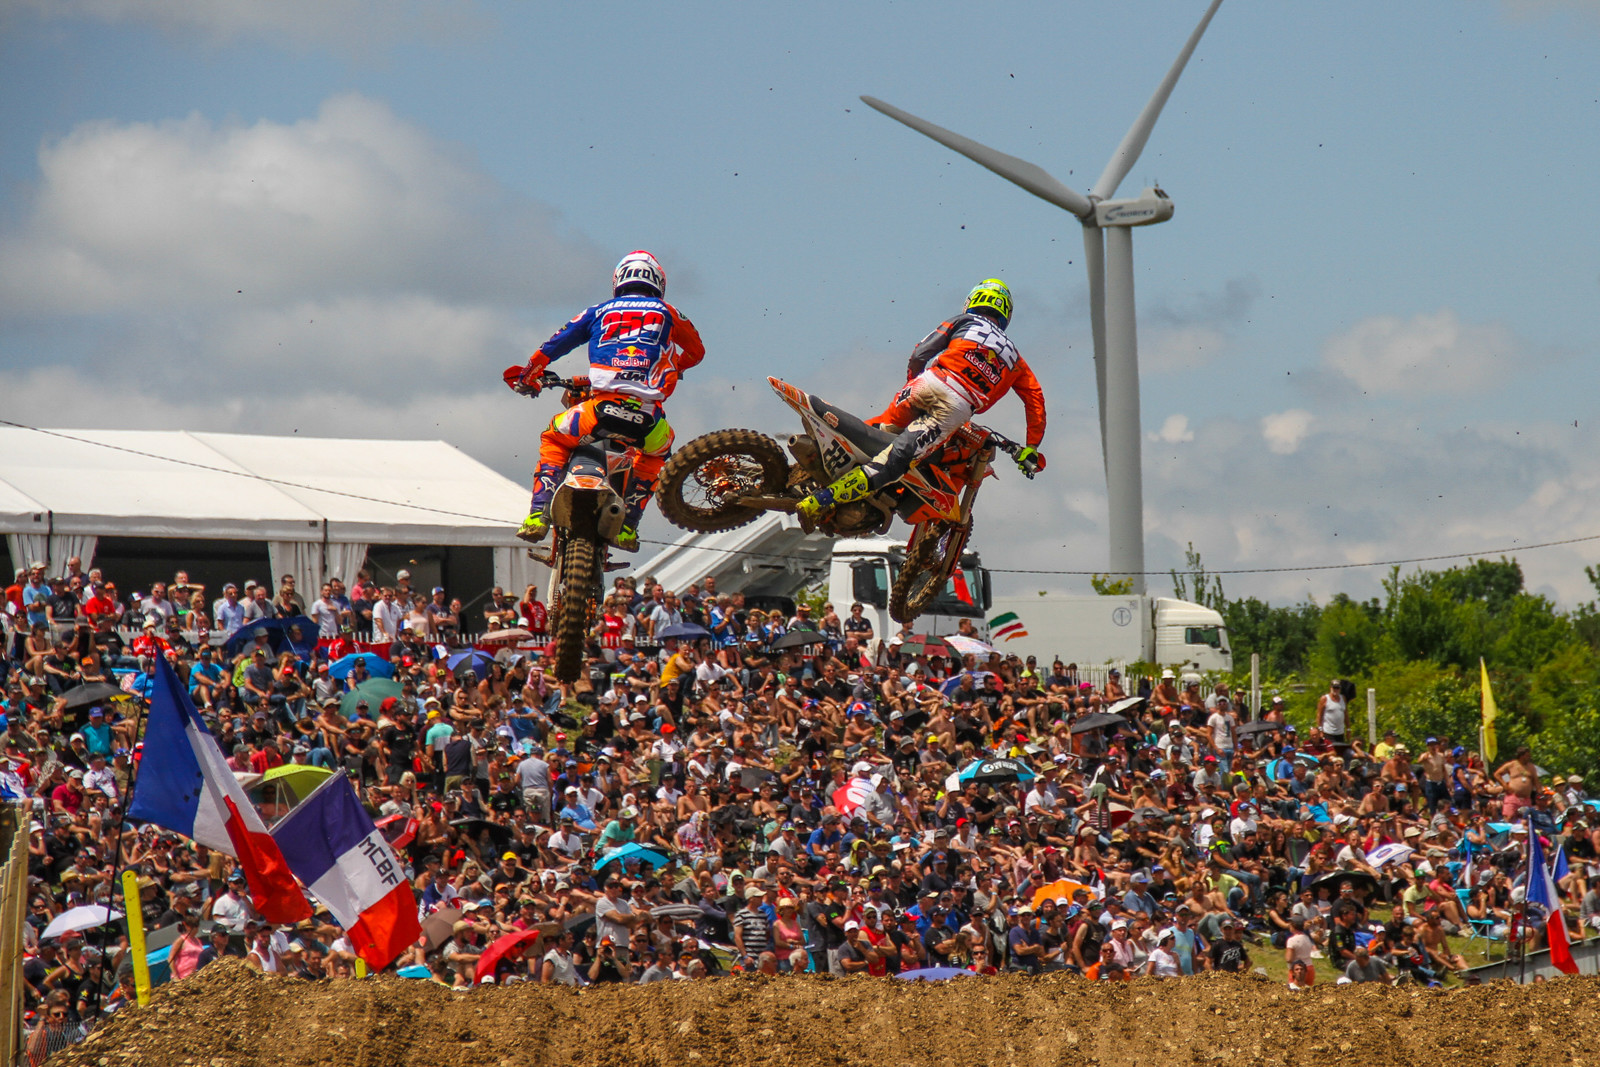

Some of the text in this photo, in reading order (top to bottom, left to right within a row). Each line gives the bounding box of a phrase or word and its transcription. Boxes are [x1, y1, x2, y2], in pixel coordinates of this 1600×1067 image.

[598, 310, 665, 347] 259
[611, 357, 650, 369] Red Bull
[614, 371, 646, 382] KTM
[964, 350, 1000, 385] Red Bull
[961, 367, 991, 395] KTM
[358, 836, 398, 885] MCBF
